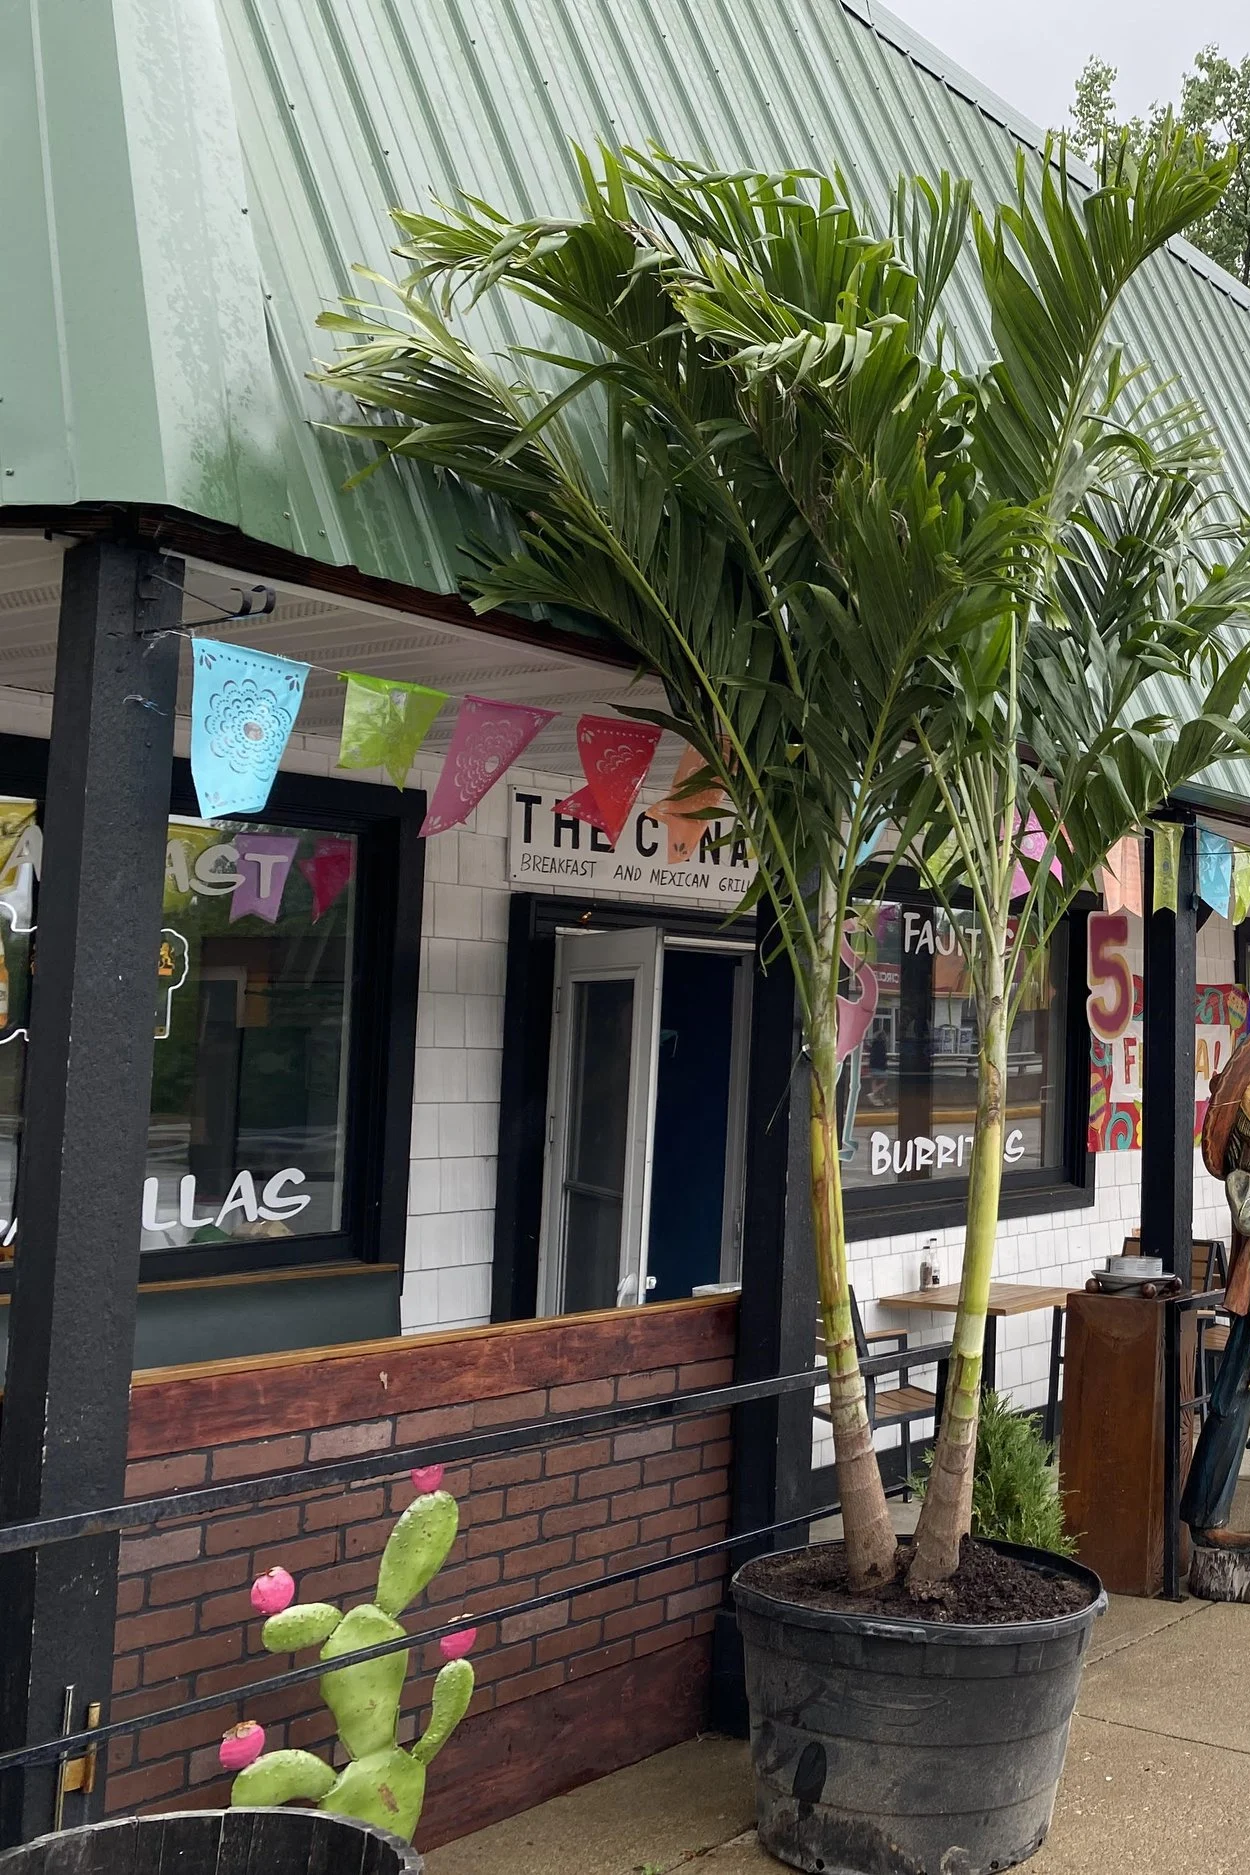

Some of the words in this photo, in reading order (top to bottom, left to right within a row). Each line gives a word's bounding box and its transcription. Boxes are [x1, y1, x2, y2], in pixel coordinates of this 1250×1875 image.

[636, 811, 750, 868] CNA
[520, 852, 597, 878] BREAKFAST
[613, 864, 642, 882] AND
[650, 868, 710, 890] MEXICAN
[1088, 914, 1134, 1041] 5
[870, 1128, 1026, 1176] BURRIS
[141, 1167, 311, 1232] LLAS
